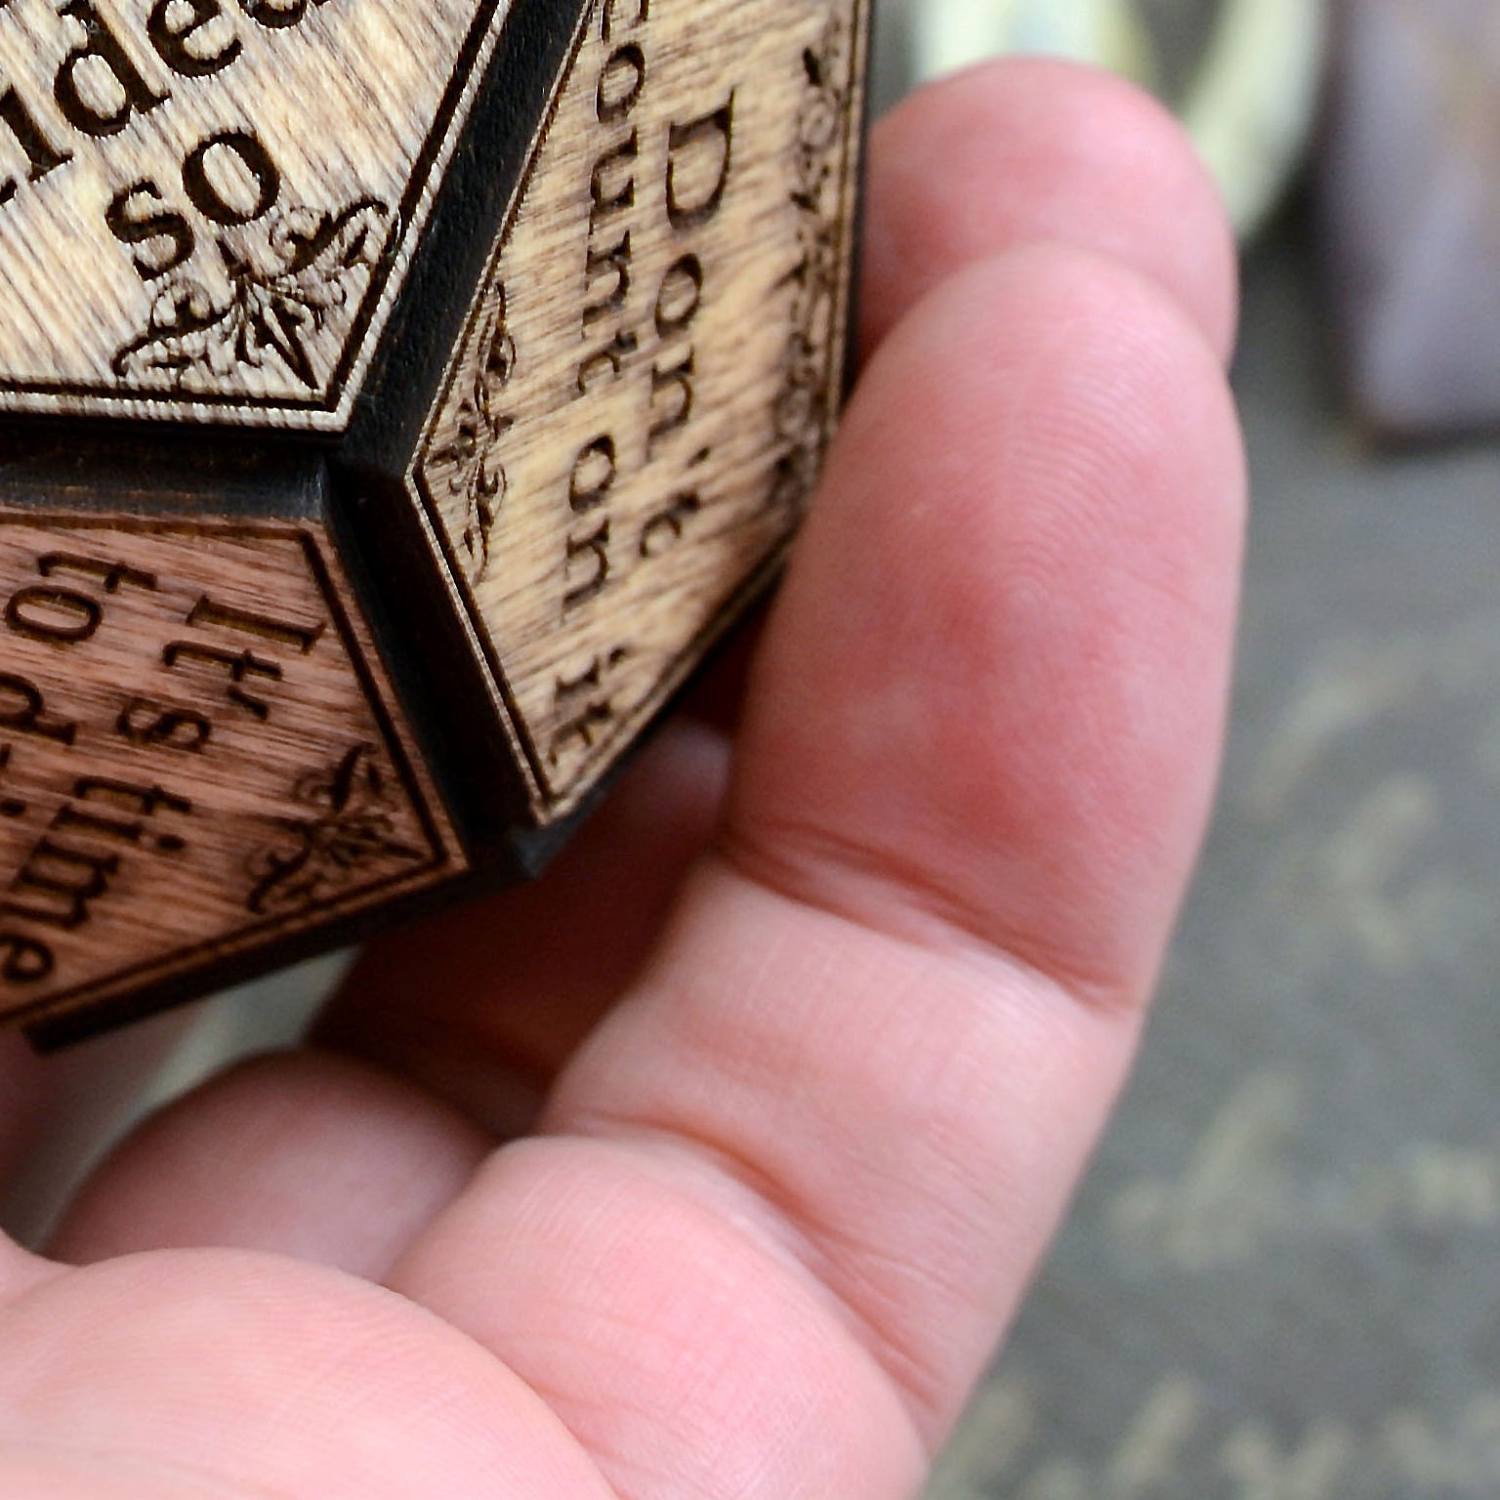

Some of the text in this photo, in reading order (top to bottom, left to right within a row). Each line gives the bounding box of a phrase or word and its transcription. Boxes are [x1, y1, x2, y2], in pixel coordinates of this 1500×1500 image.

[104, 130, 280, 282] so
[640, 87, 738, 560] Don't
[2, 548, 159, 645] to
[562, 434, 616, 622] on
[116, 596, 327, 754] It's
[549, 648, 625, 766] it
